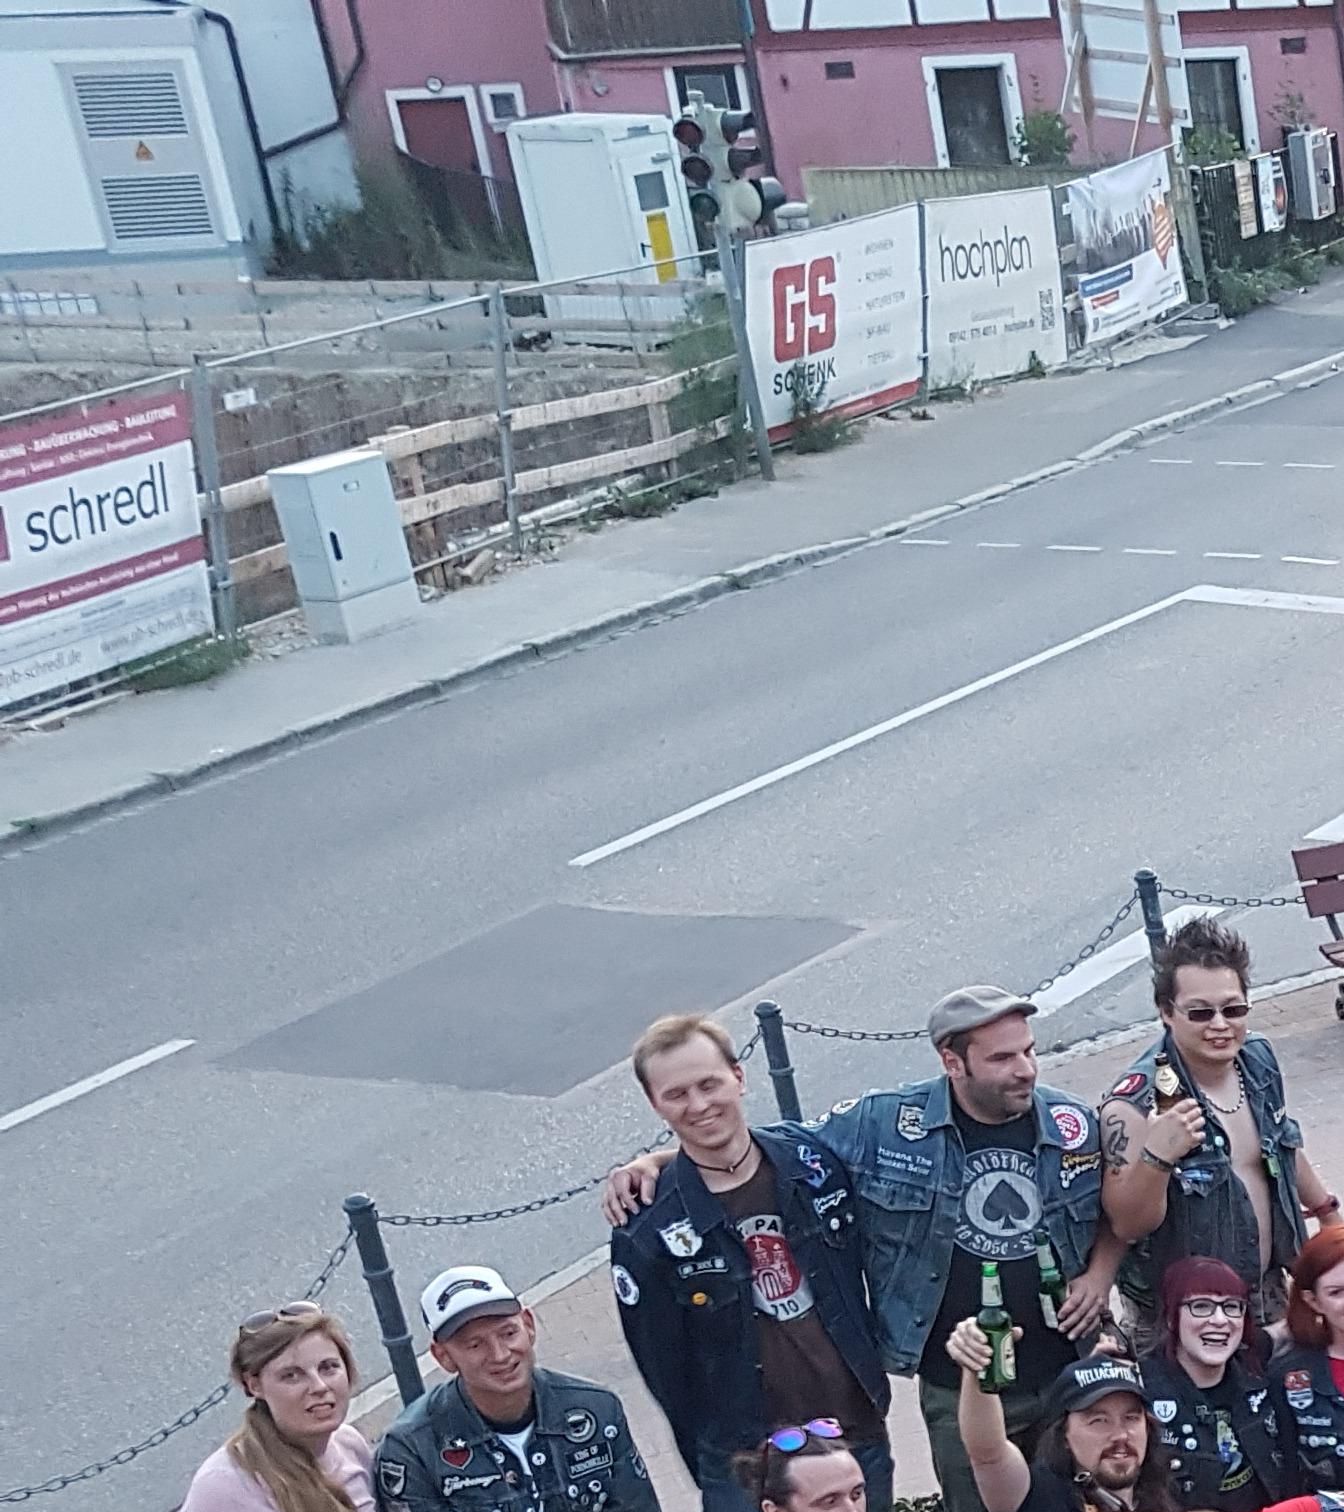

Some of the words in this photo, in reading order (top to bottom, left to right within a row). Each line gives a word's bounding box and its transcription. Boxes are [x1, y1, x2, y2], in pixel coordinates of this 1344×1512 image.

[939, 225, 1033, 287] hochplan
[773, 255, 837, 364] GS
[26, 461, 169, 552] schredl
